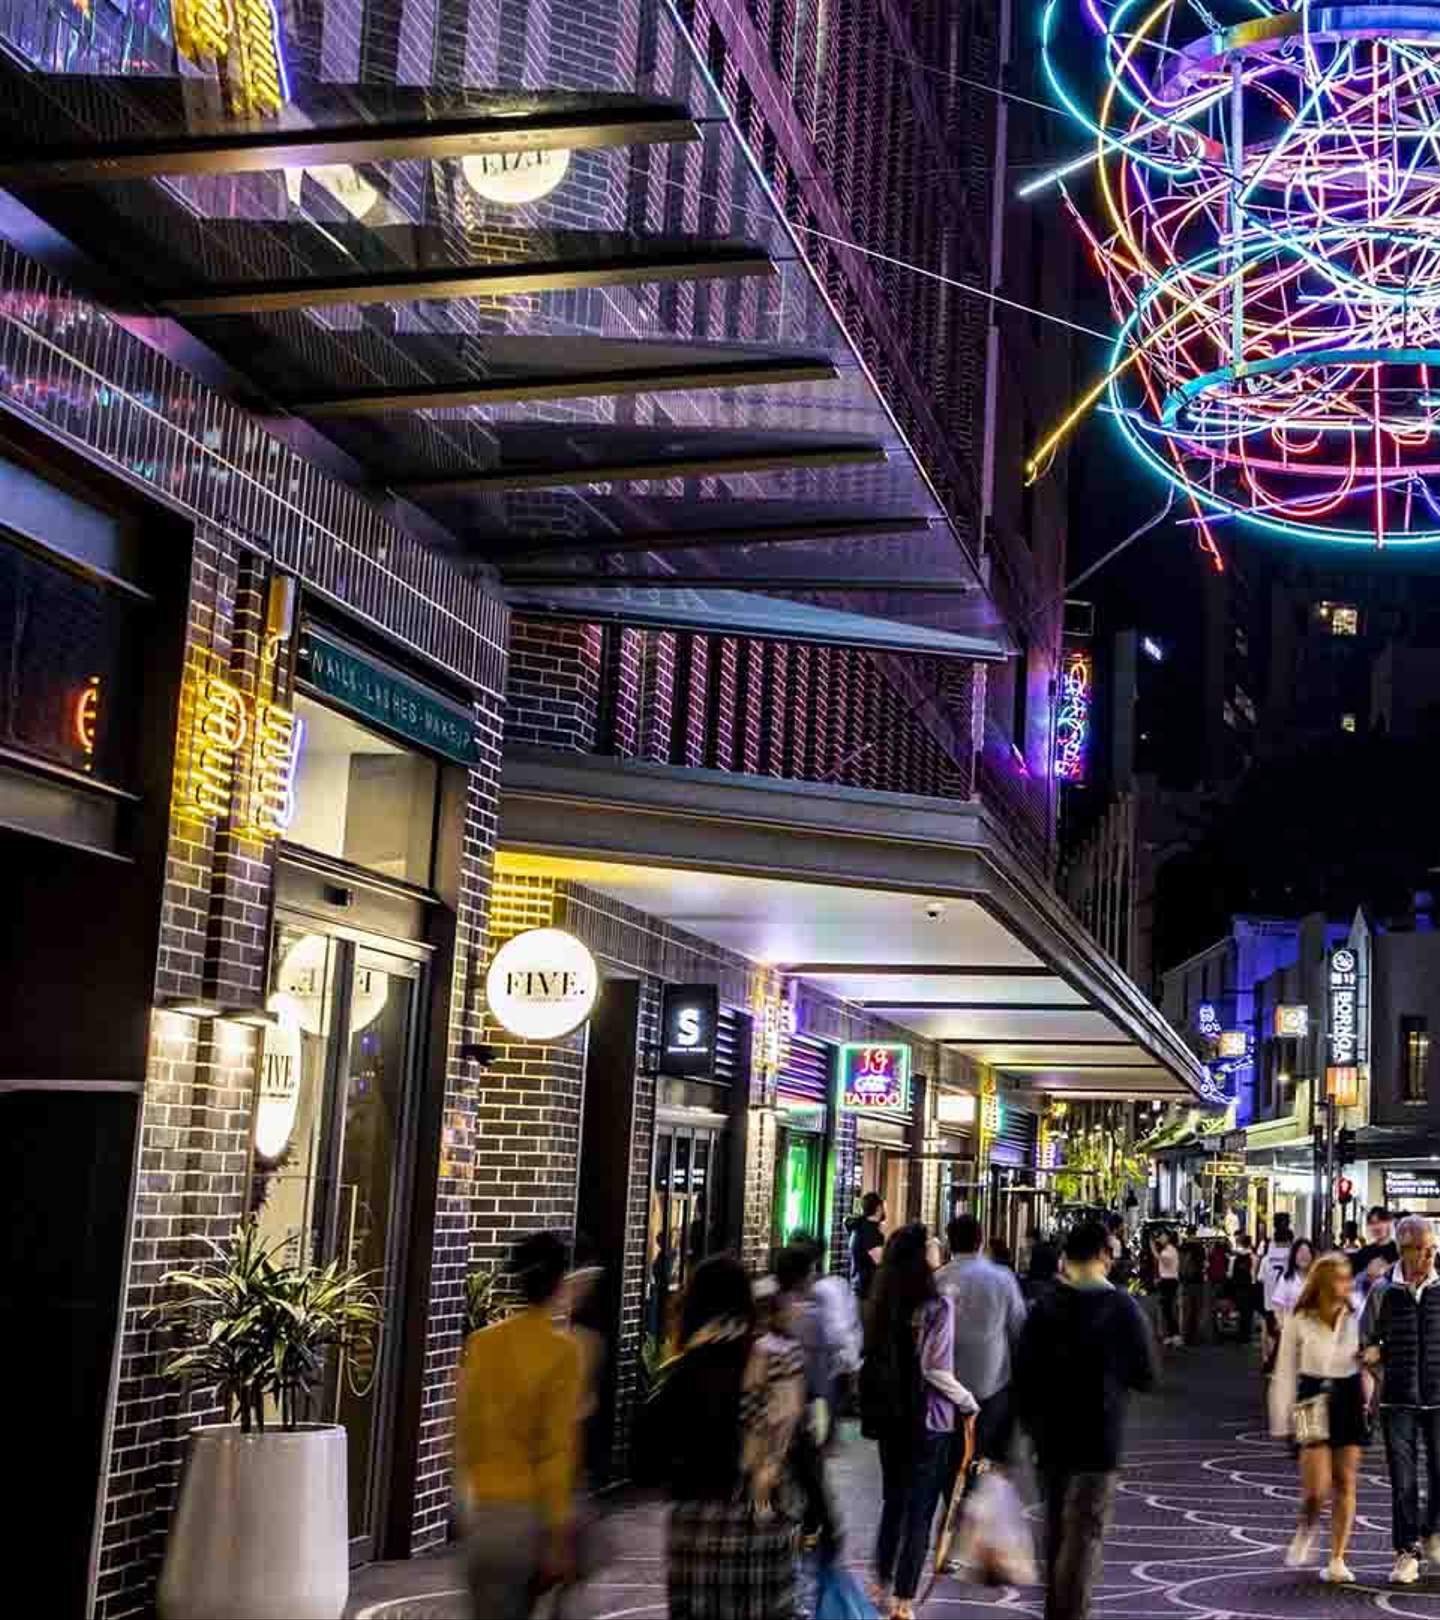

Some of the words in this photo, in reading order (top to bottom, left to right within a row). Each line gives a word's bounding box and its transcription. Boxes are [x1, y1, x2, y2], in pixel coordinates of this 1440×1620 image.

[677, 1008, 699, 1046] S
[844, 1092, 901, 1106] TATTOO
[1272, 1264, 1285, 1284] 7
